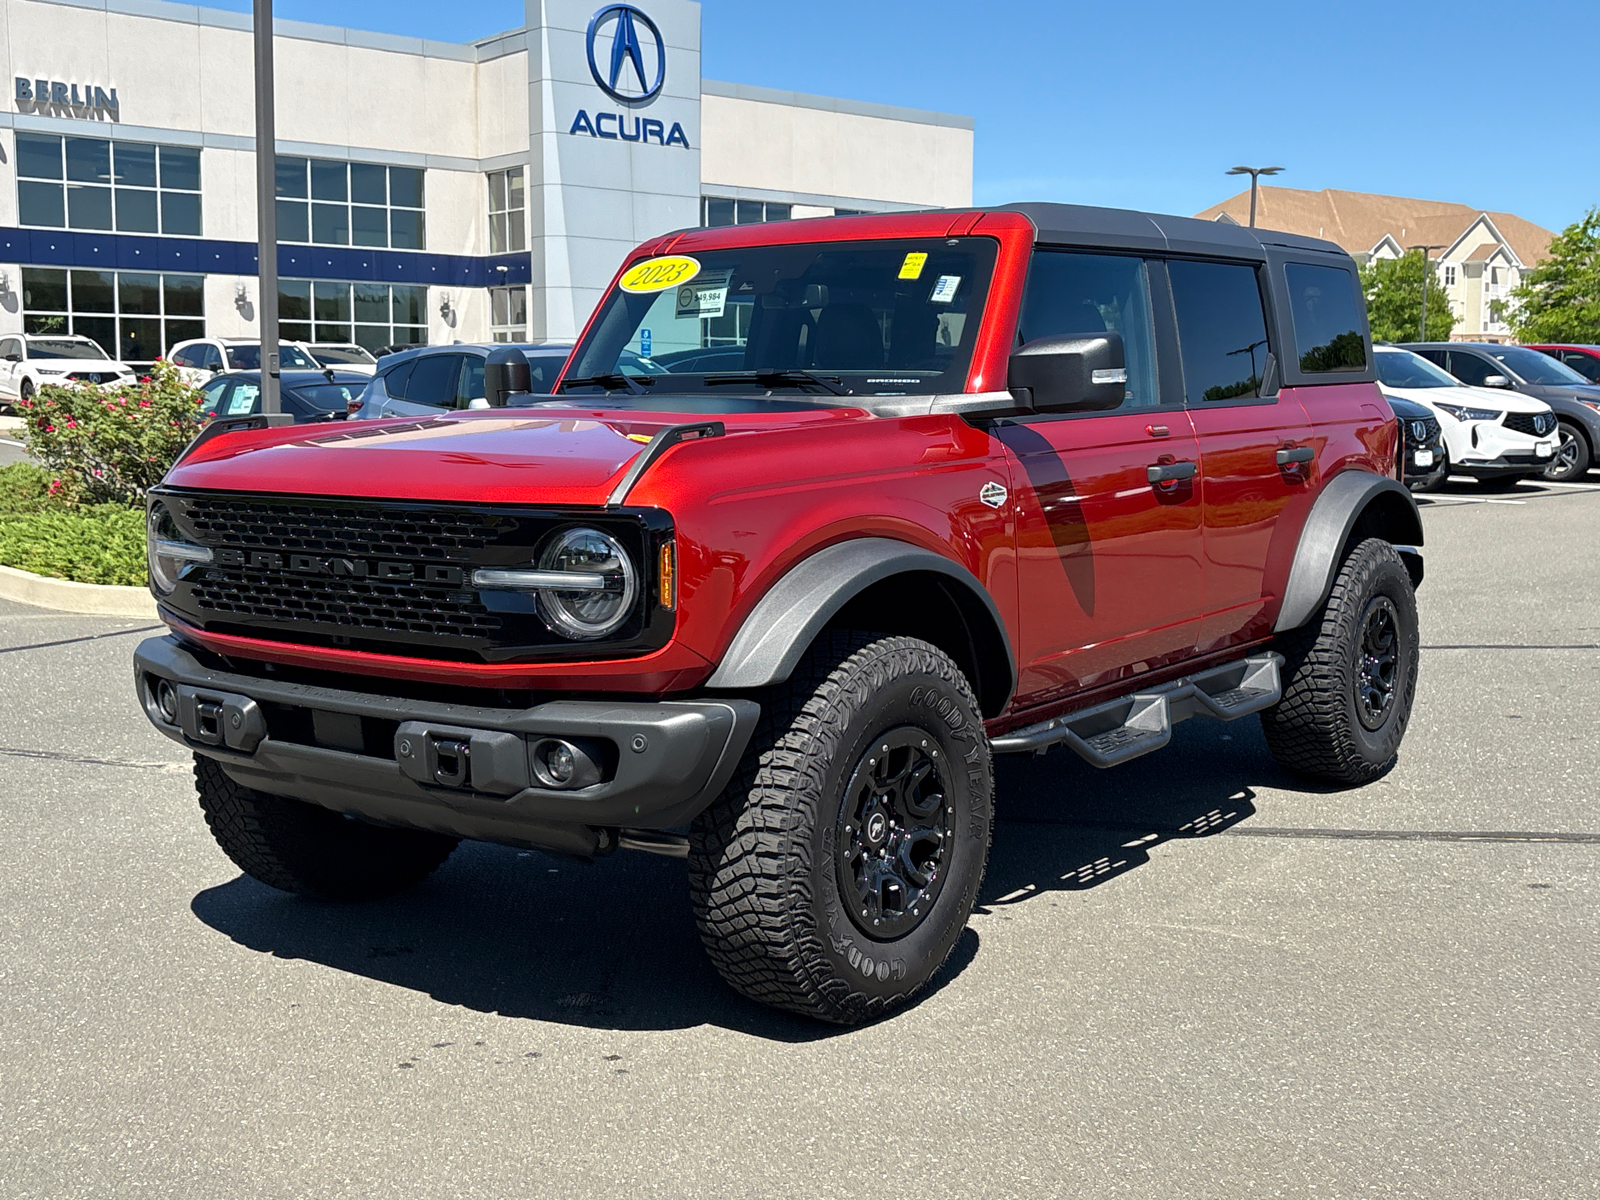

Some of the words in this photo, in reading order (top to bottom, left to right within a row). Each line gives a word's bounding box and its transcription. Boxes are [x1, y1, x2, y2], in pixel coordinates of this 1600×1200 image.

[15, 77, 117, 110] BERLIN
[569, 109, 690, 150] ACURA
[629, 263, 689, 287] 2023
[694, 292, 721, 303] $49,984
[213, 549, 463, 584] BRONCO
[909, 686, 986, 841] GOODYEAR
